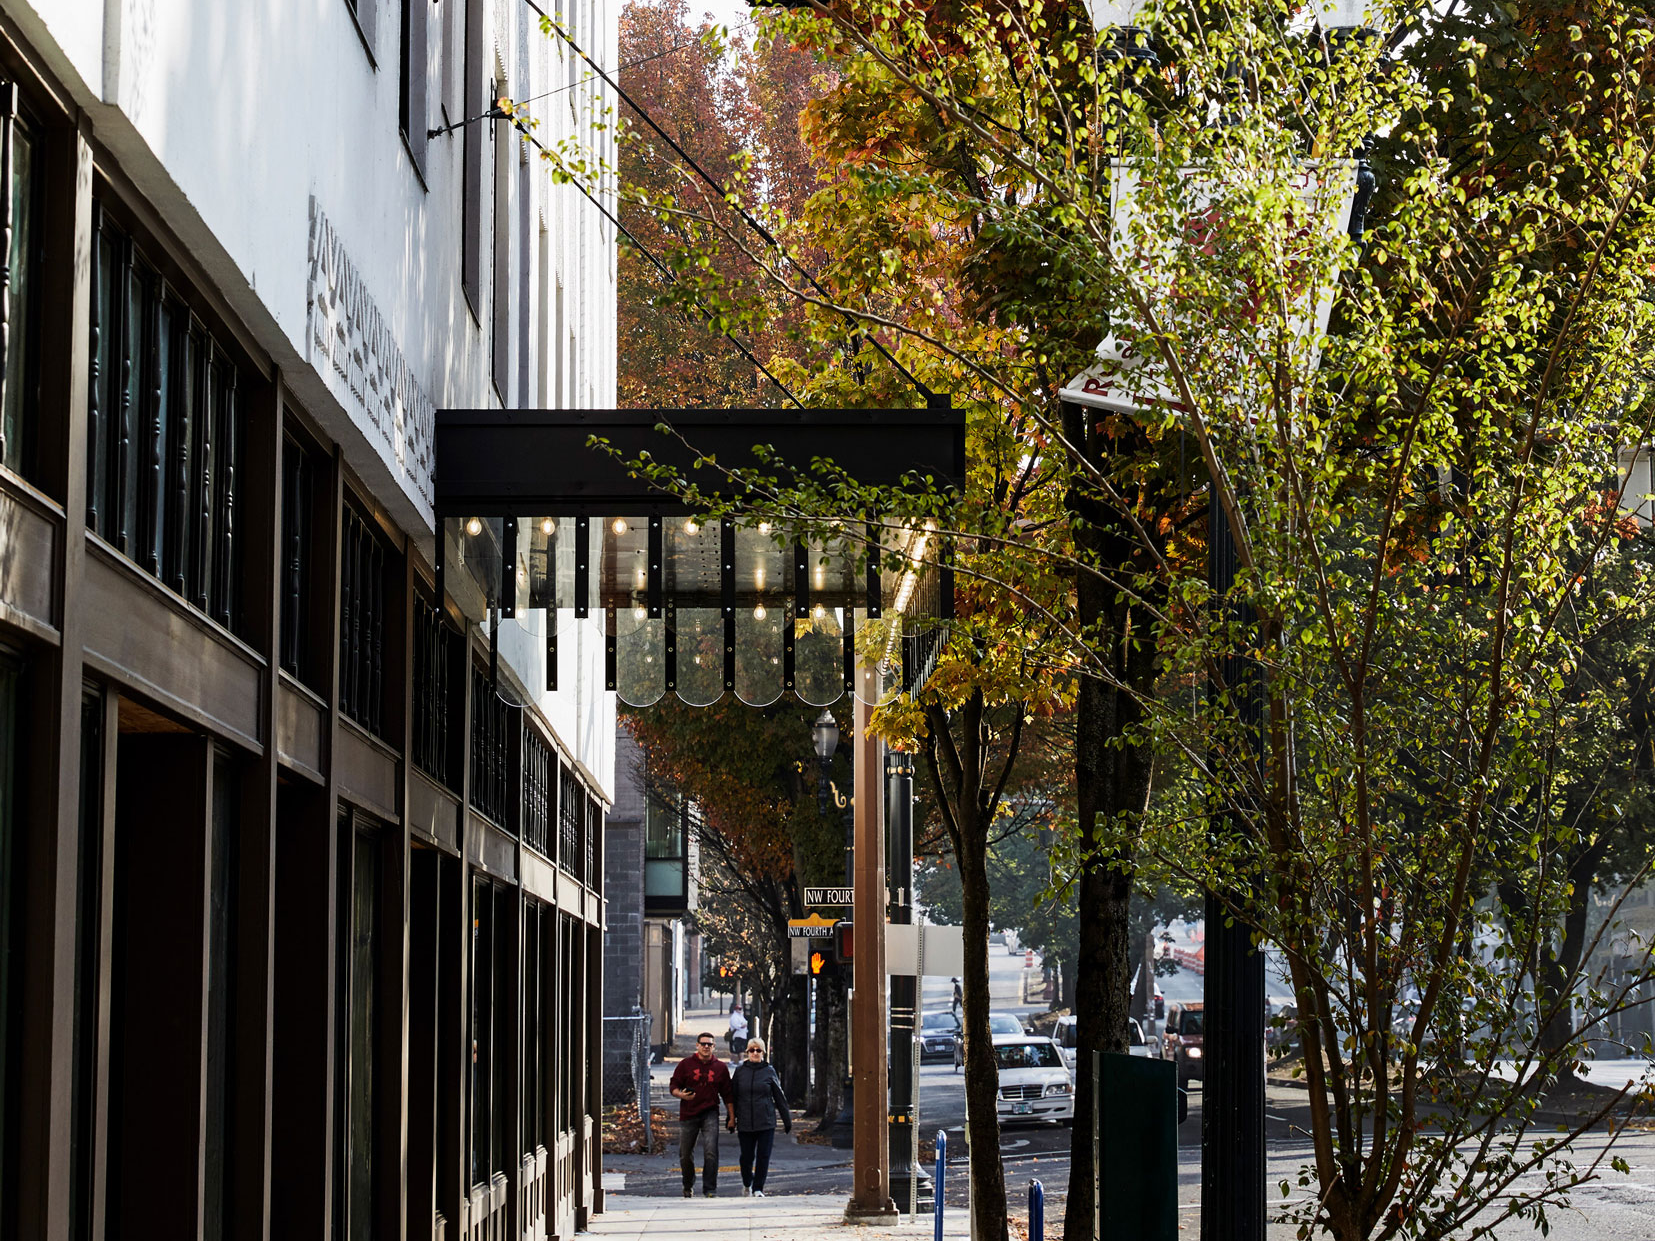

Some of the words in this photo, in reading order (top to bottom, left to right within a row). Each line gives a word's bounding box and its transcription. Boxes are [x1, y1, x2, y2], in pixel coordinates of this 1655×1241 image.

[807, 890, 823, 903] NW
[789, 926, 801, 936] NW
[802, 926, 827, 936] FOURTH
